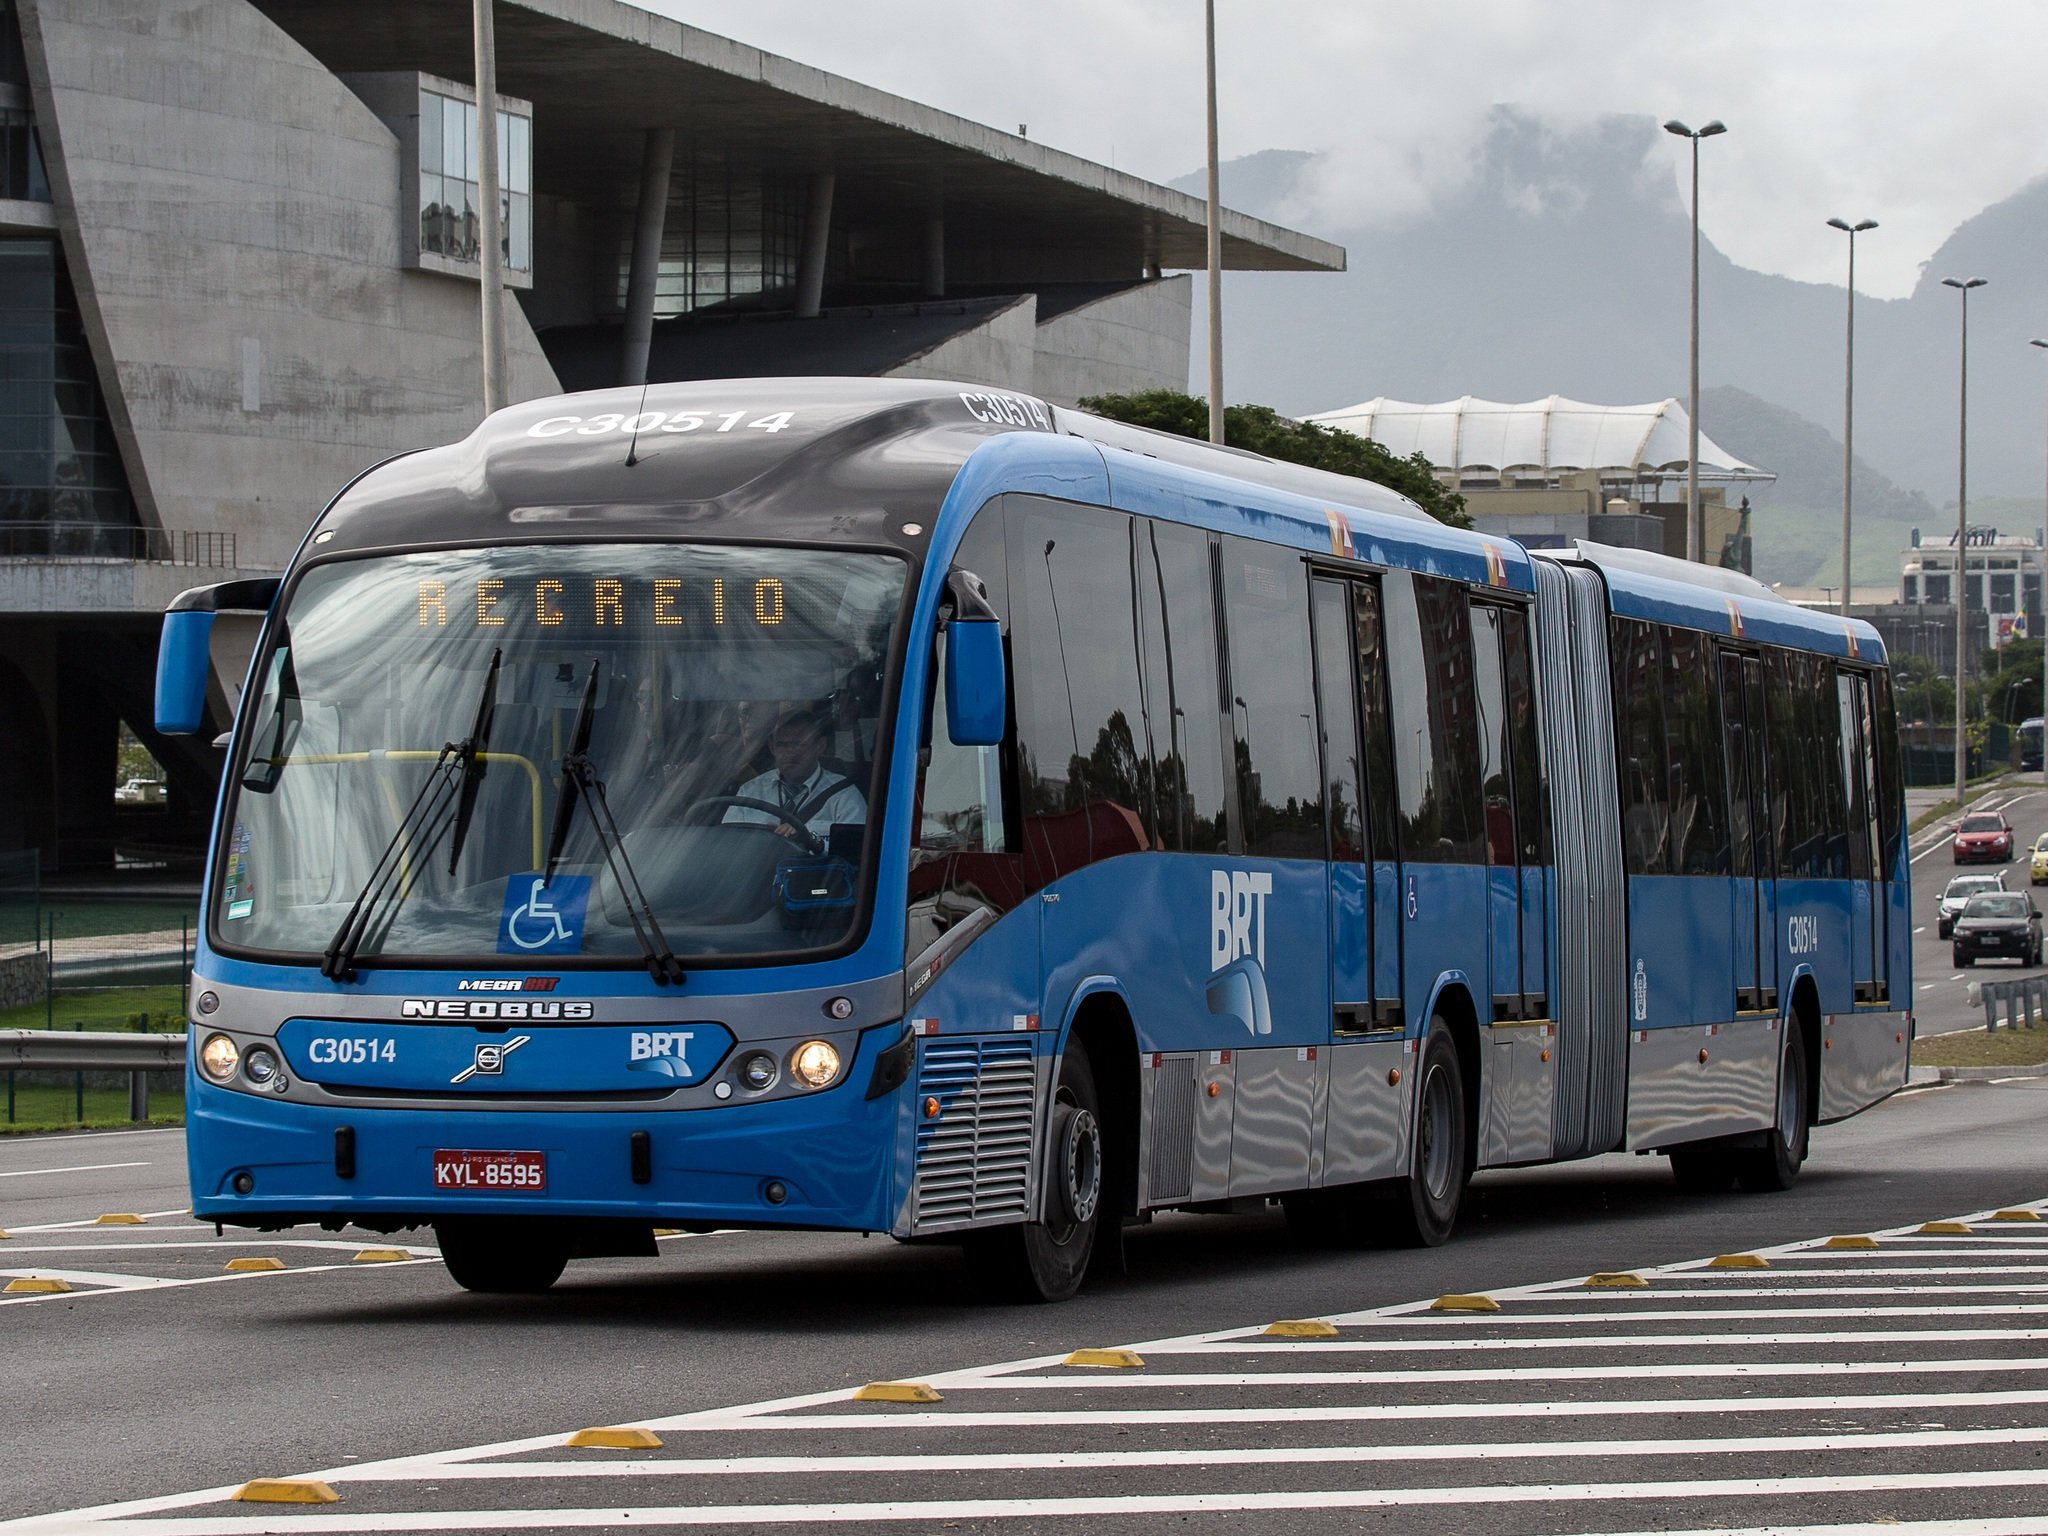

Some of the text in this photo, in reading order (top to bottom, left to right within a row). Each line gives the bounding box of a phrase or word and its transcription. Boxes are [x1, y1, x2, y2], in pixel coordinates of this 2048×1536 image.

[527, 411, 795, 438] C30514
[957, 392, 1049, 430] C30514
[418, 578, 783, 625] RECREIO
[1211, 870, 1272, 972] BRT
[1789, 915, 1817, 953] C30514
[402, 1000, 594, 1020] NEOBUS
[308, 1037, 396, 1064] C30514
[630, 1032, 694, 1060] BRT
